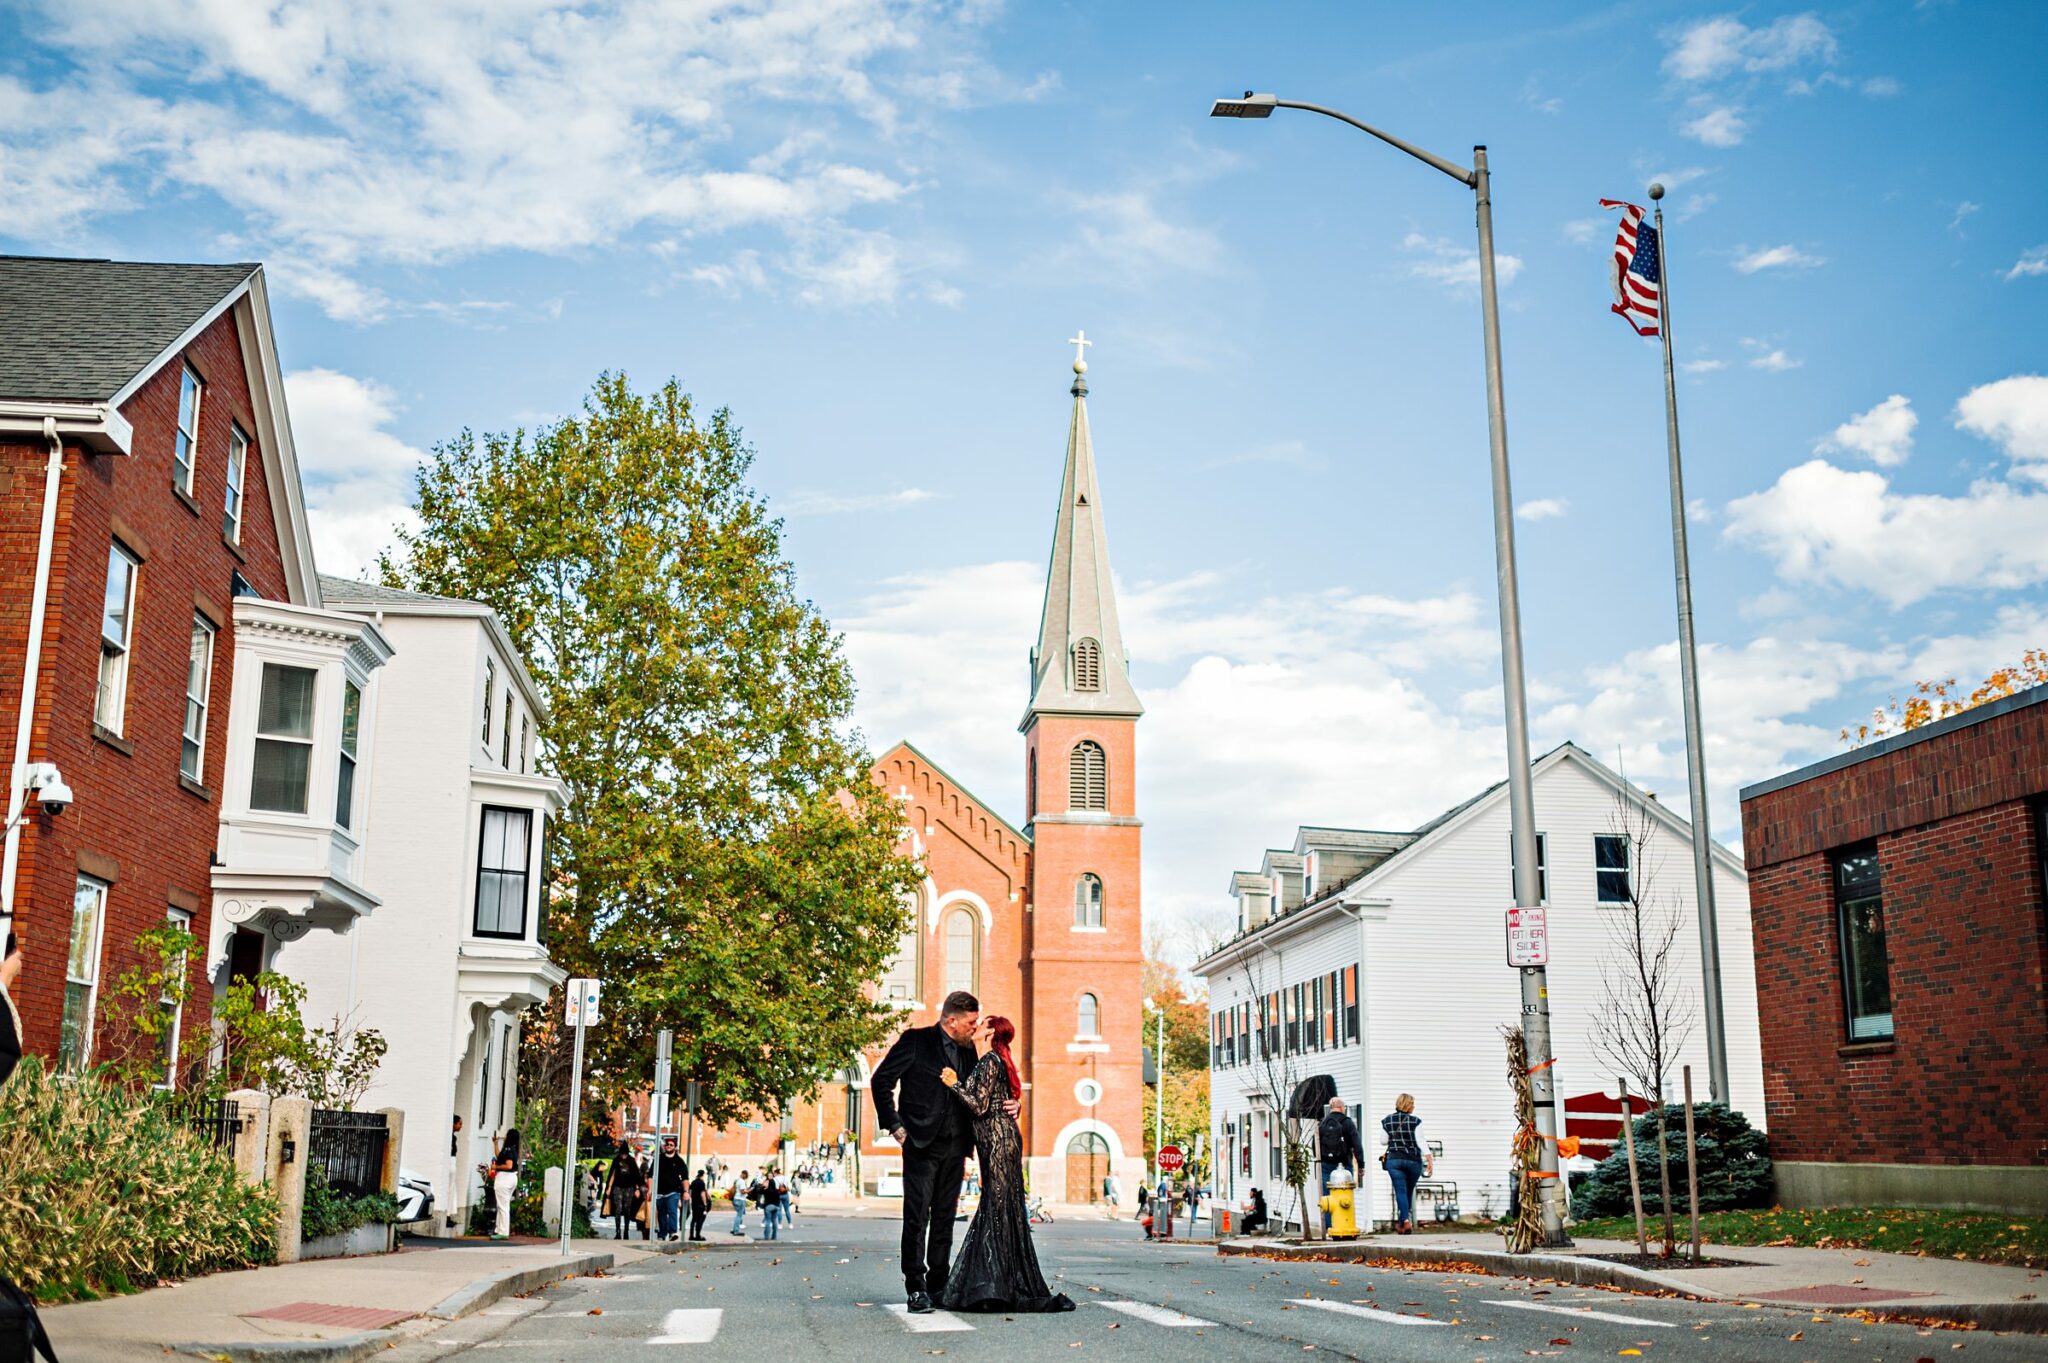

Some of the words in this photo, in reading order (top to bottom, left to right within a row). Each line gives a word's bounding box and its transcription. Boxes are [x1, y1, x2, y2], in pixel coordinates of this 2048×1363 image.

[1508, 913, 1519, 924] NO
[1516, 941, 1540, 951] SIDE
[1159, 1153, 1182, 1164] STOP
